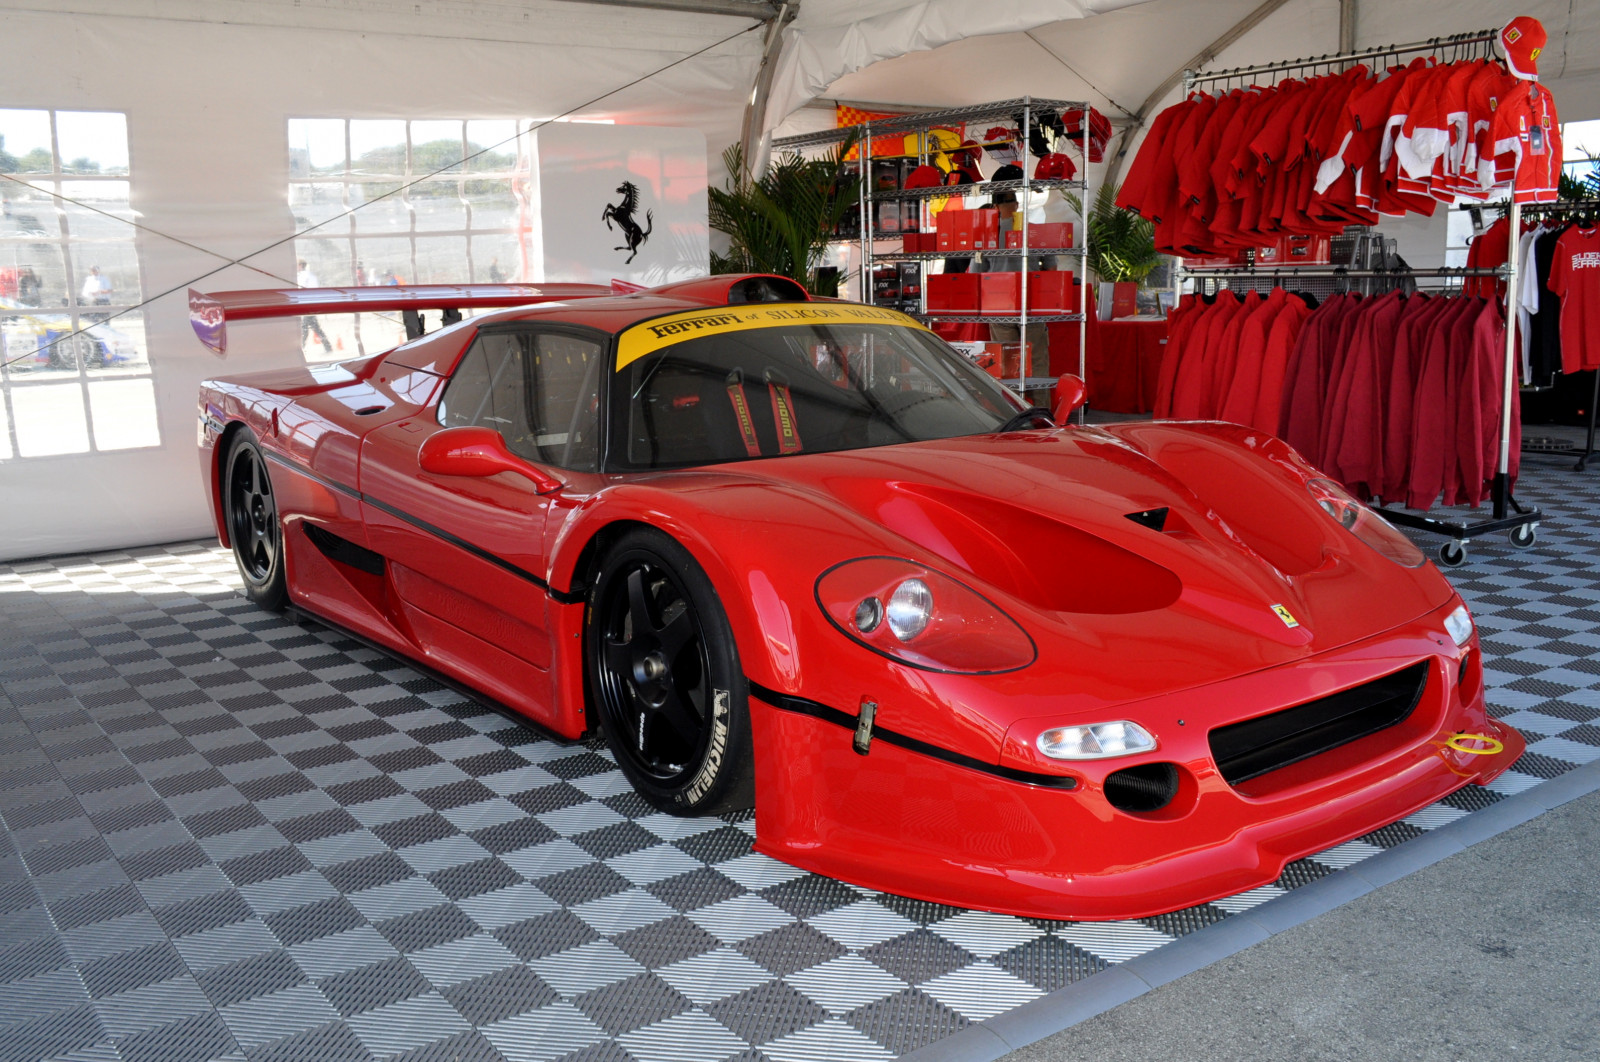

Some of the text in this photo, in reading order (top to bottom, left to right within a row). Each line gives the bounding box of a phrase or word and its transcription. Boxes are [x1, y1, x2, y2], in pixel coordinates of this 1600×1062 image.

[646, 313, 744, 339] Ferrari
[765, 309, 842, 320] SILICON
[844, 309, 911, 323] VALLEY
[686, 720, 727, 805] MICHELIN
